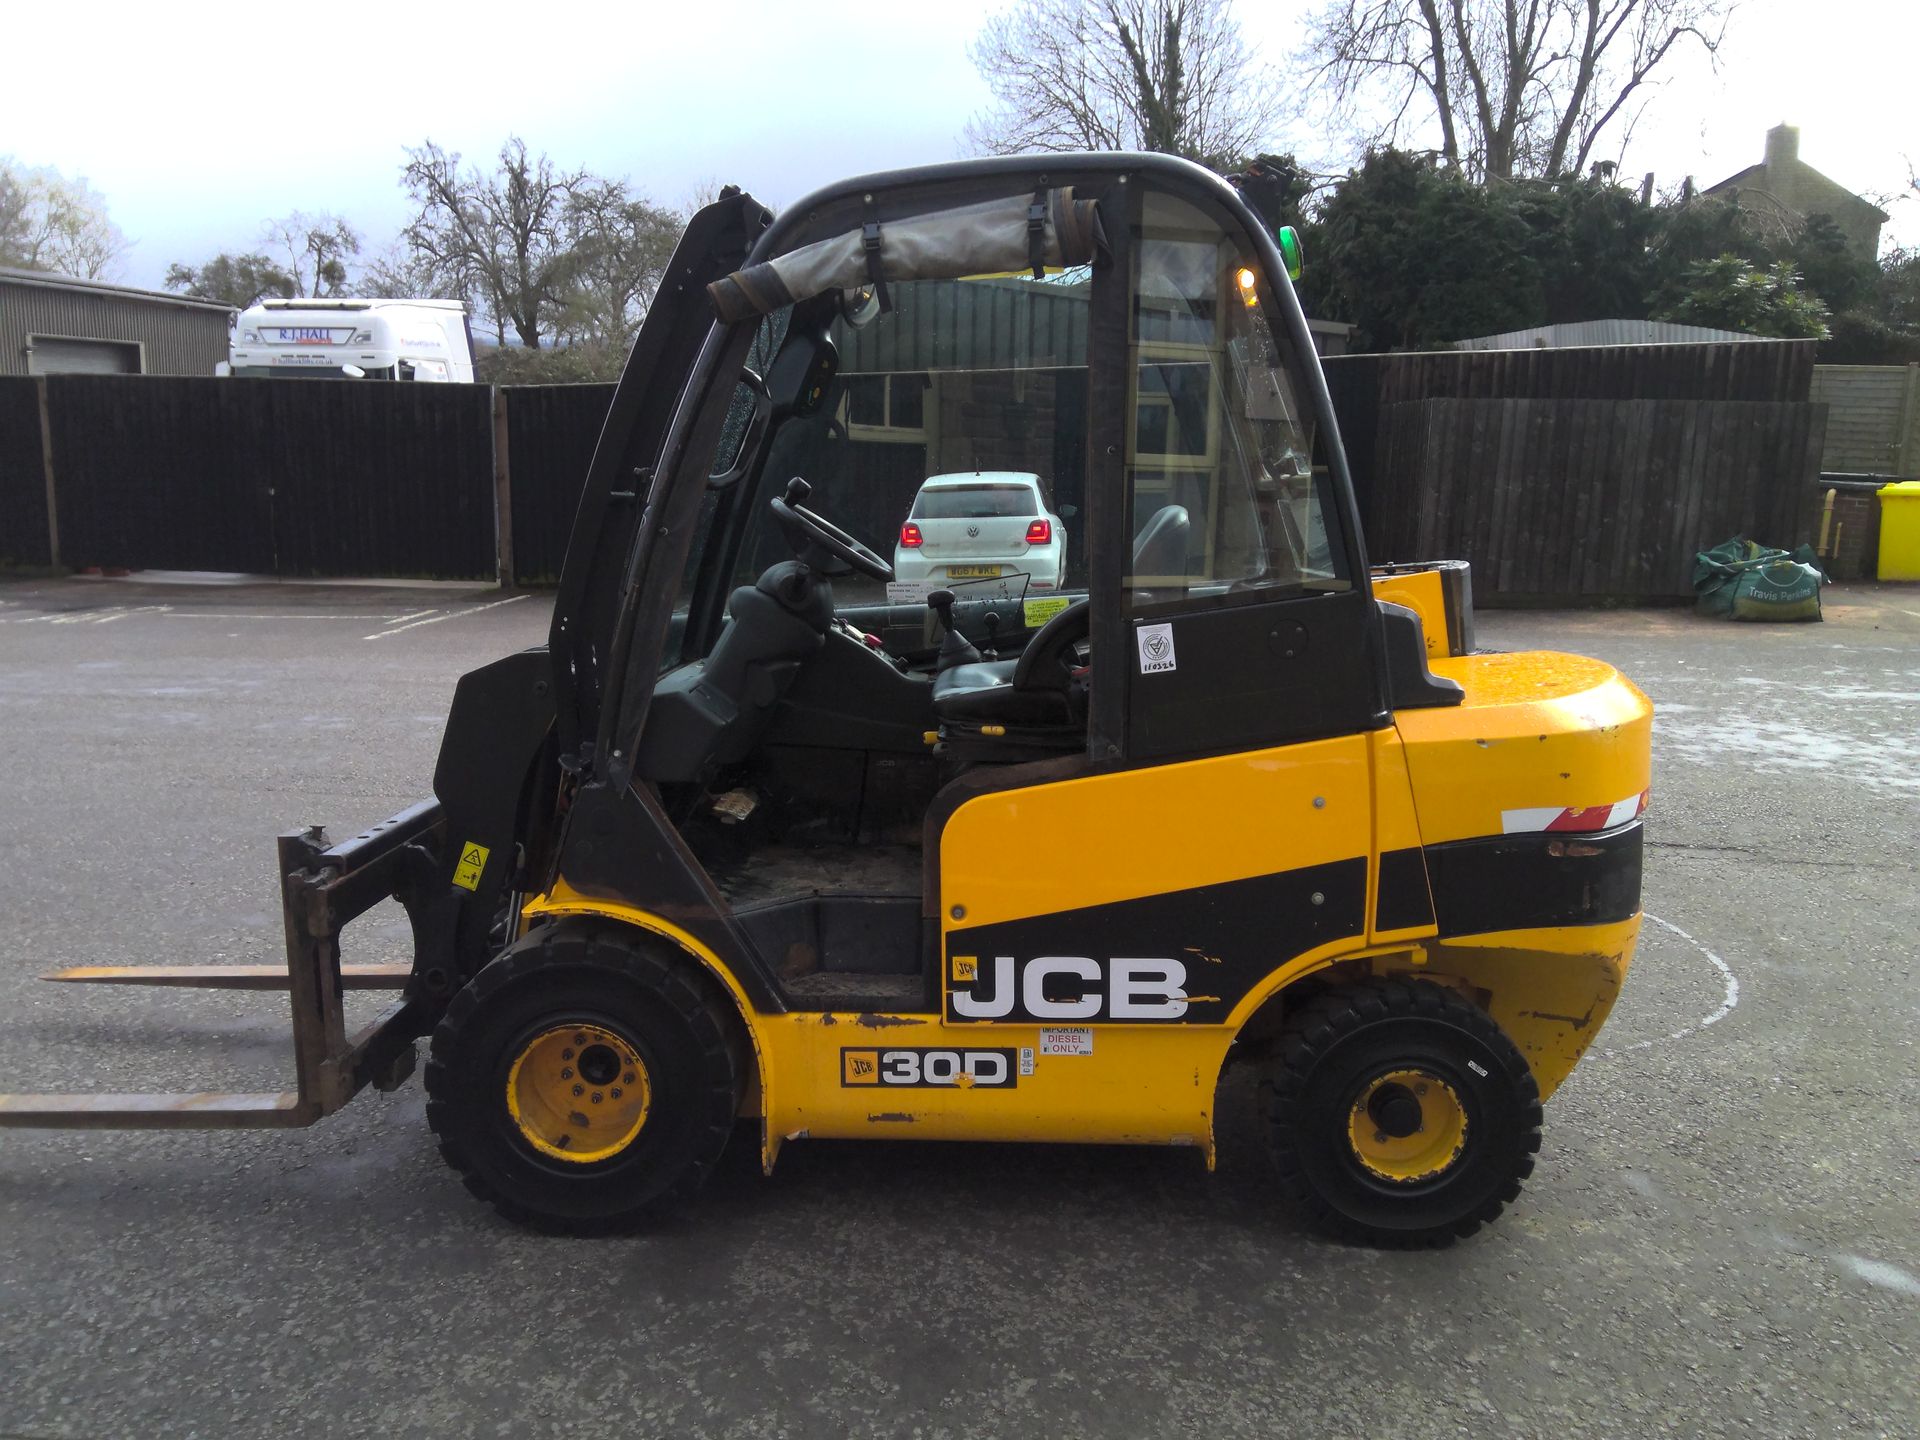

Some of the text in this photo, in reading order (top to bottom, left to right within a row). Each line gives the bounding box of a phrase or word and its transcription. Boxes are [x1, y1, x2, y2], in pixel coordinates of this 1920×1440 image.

[1749, 586, 1811, 601] Travis Perkins
[953, 956, 1189, 1019] JCB
[1048, 1035, 1084, 1043] DIESEL
[1052, 1044, 1079, 1053] ONLY
[853, 1059, 873, 1075] JCB
[882, 1051, 1008, 1084] 30D
